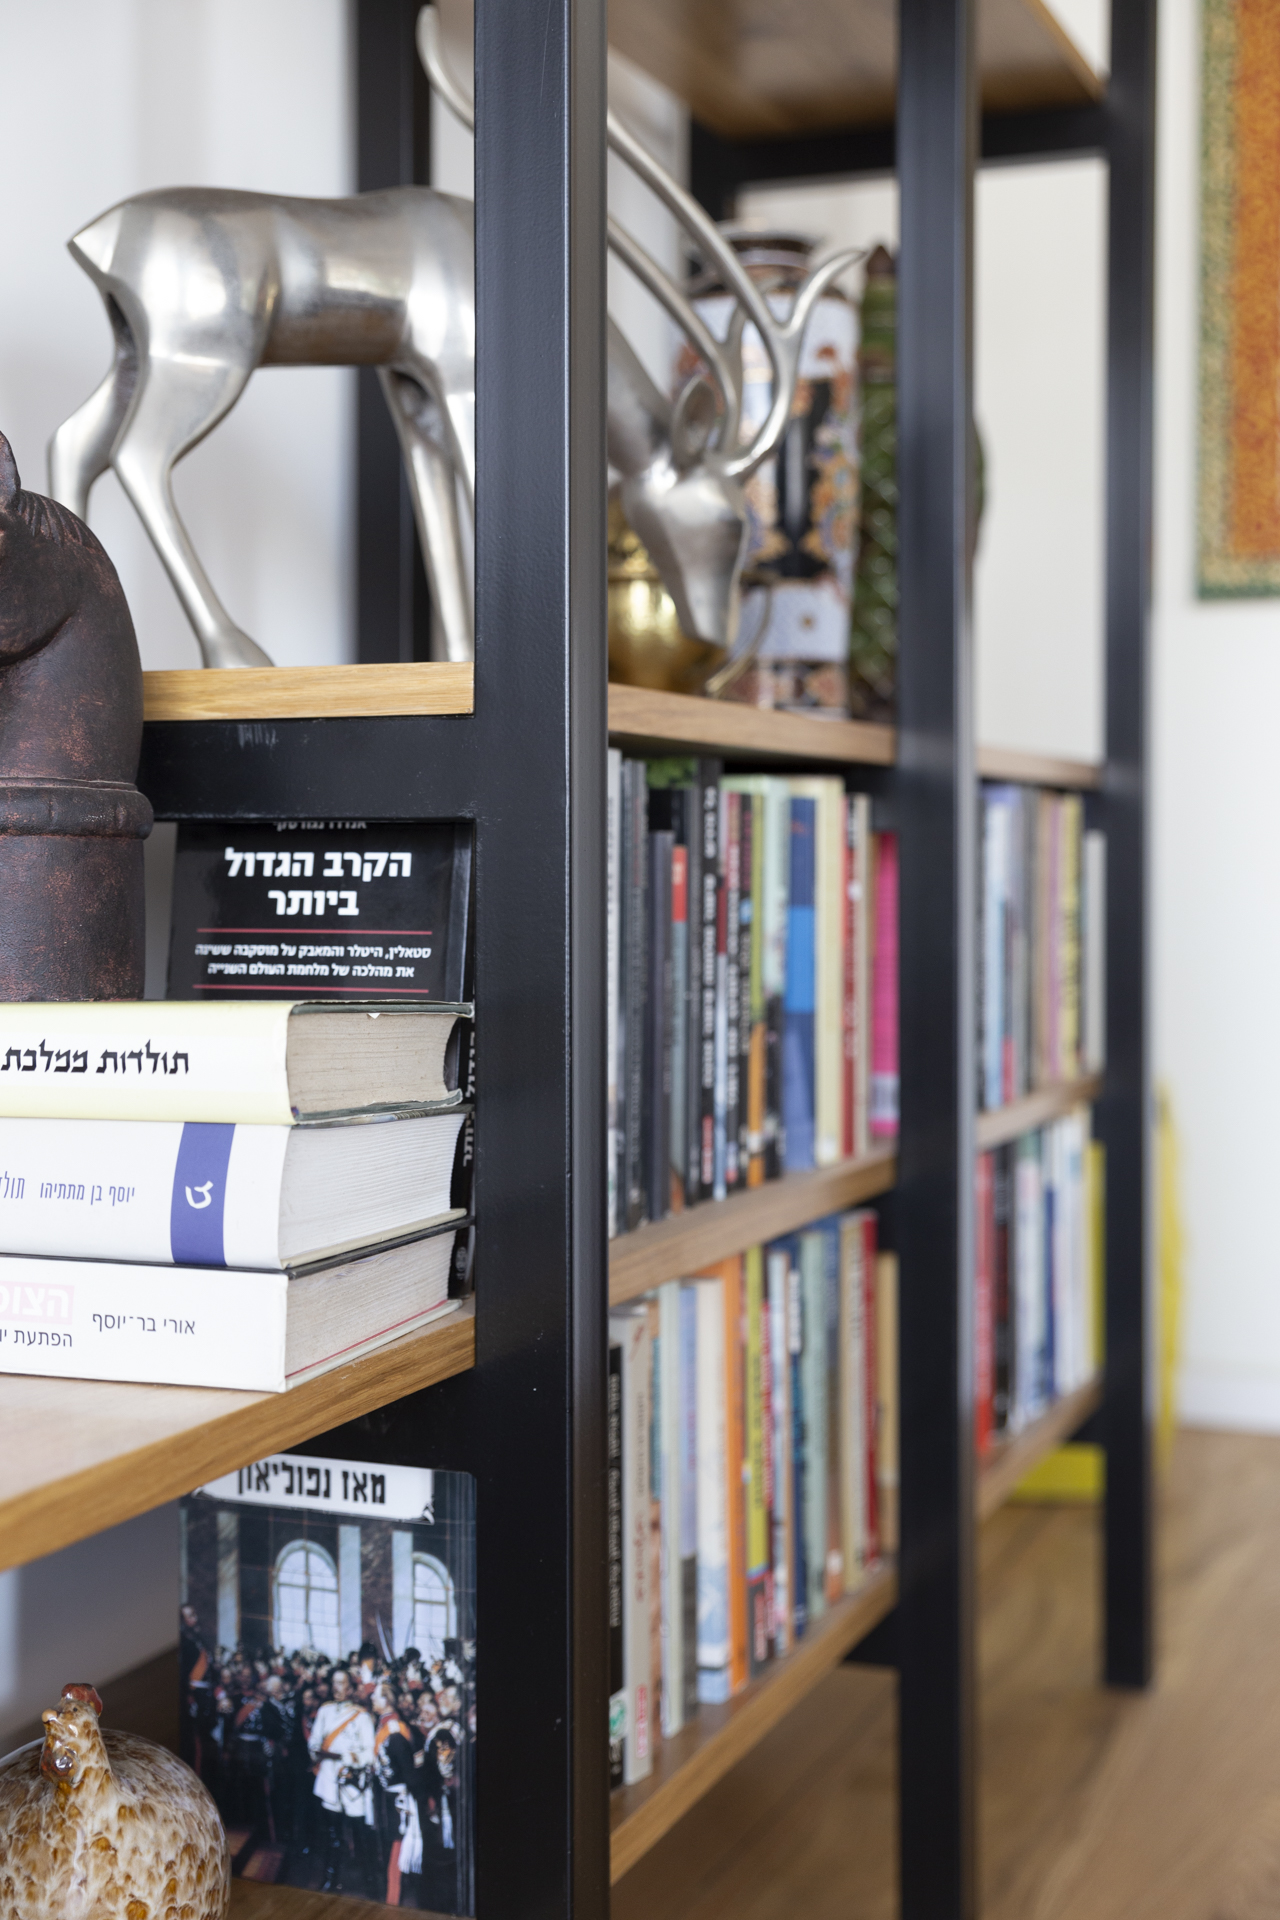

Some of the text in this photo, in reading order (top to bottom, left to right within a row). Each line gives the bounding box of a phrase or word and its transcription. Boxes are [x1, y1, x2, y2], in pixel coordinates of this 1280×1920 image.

[225, 847, 412, 882] הקרב הגדול
[268, 890, 360, 915] ביותר
[233, 944, 279, 959] מוסקבה
[280, 943, 297, 957] על
[298, 945, 345, 959] והמאבק
[347, 944, 384, 958] היטלר
[385, 944, 432, 960] סטאלין,
[207, 961, 415, 978] את מהלכה של מלחמת העולם השנייה
[0, 1038, 190, 1075] תולדות ממלכת
[0, 1170, 26, 1200] תול
[40, 1182, 135, 1207] יוסף בן מתתיהו
[163, 1317, 196, 1335] אורי
[13, 1330, 73, 1348] הפתעת
[238, 1460, 386, 1504] מאז נפוליאון
